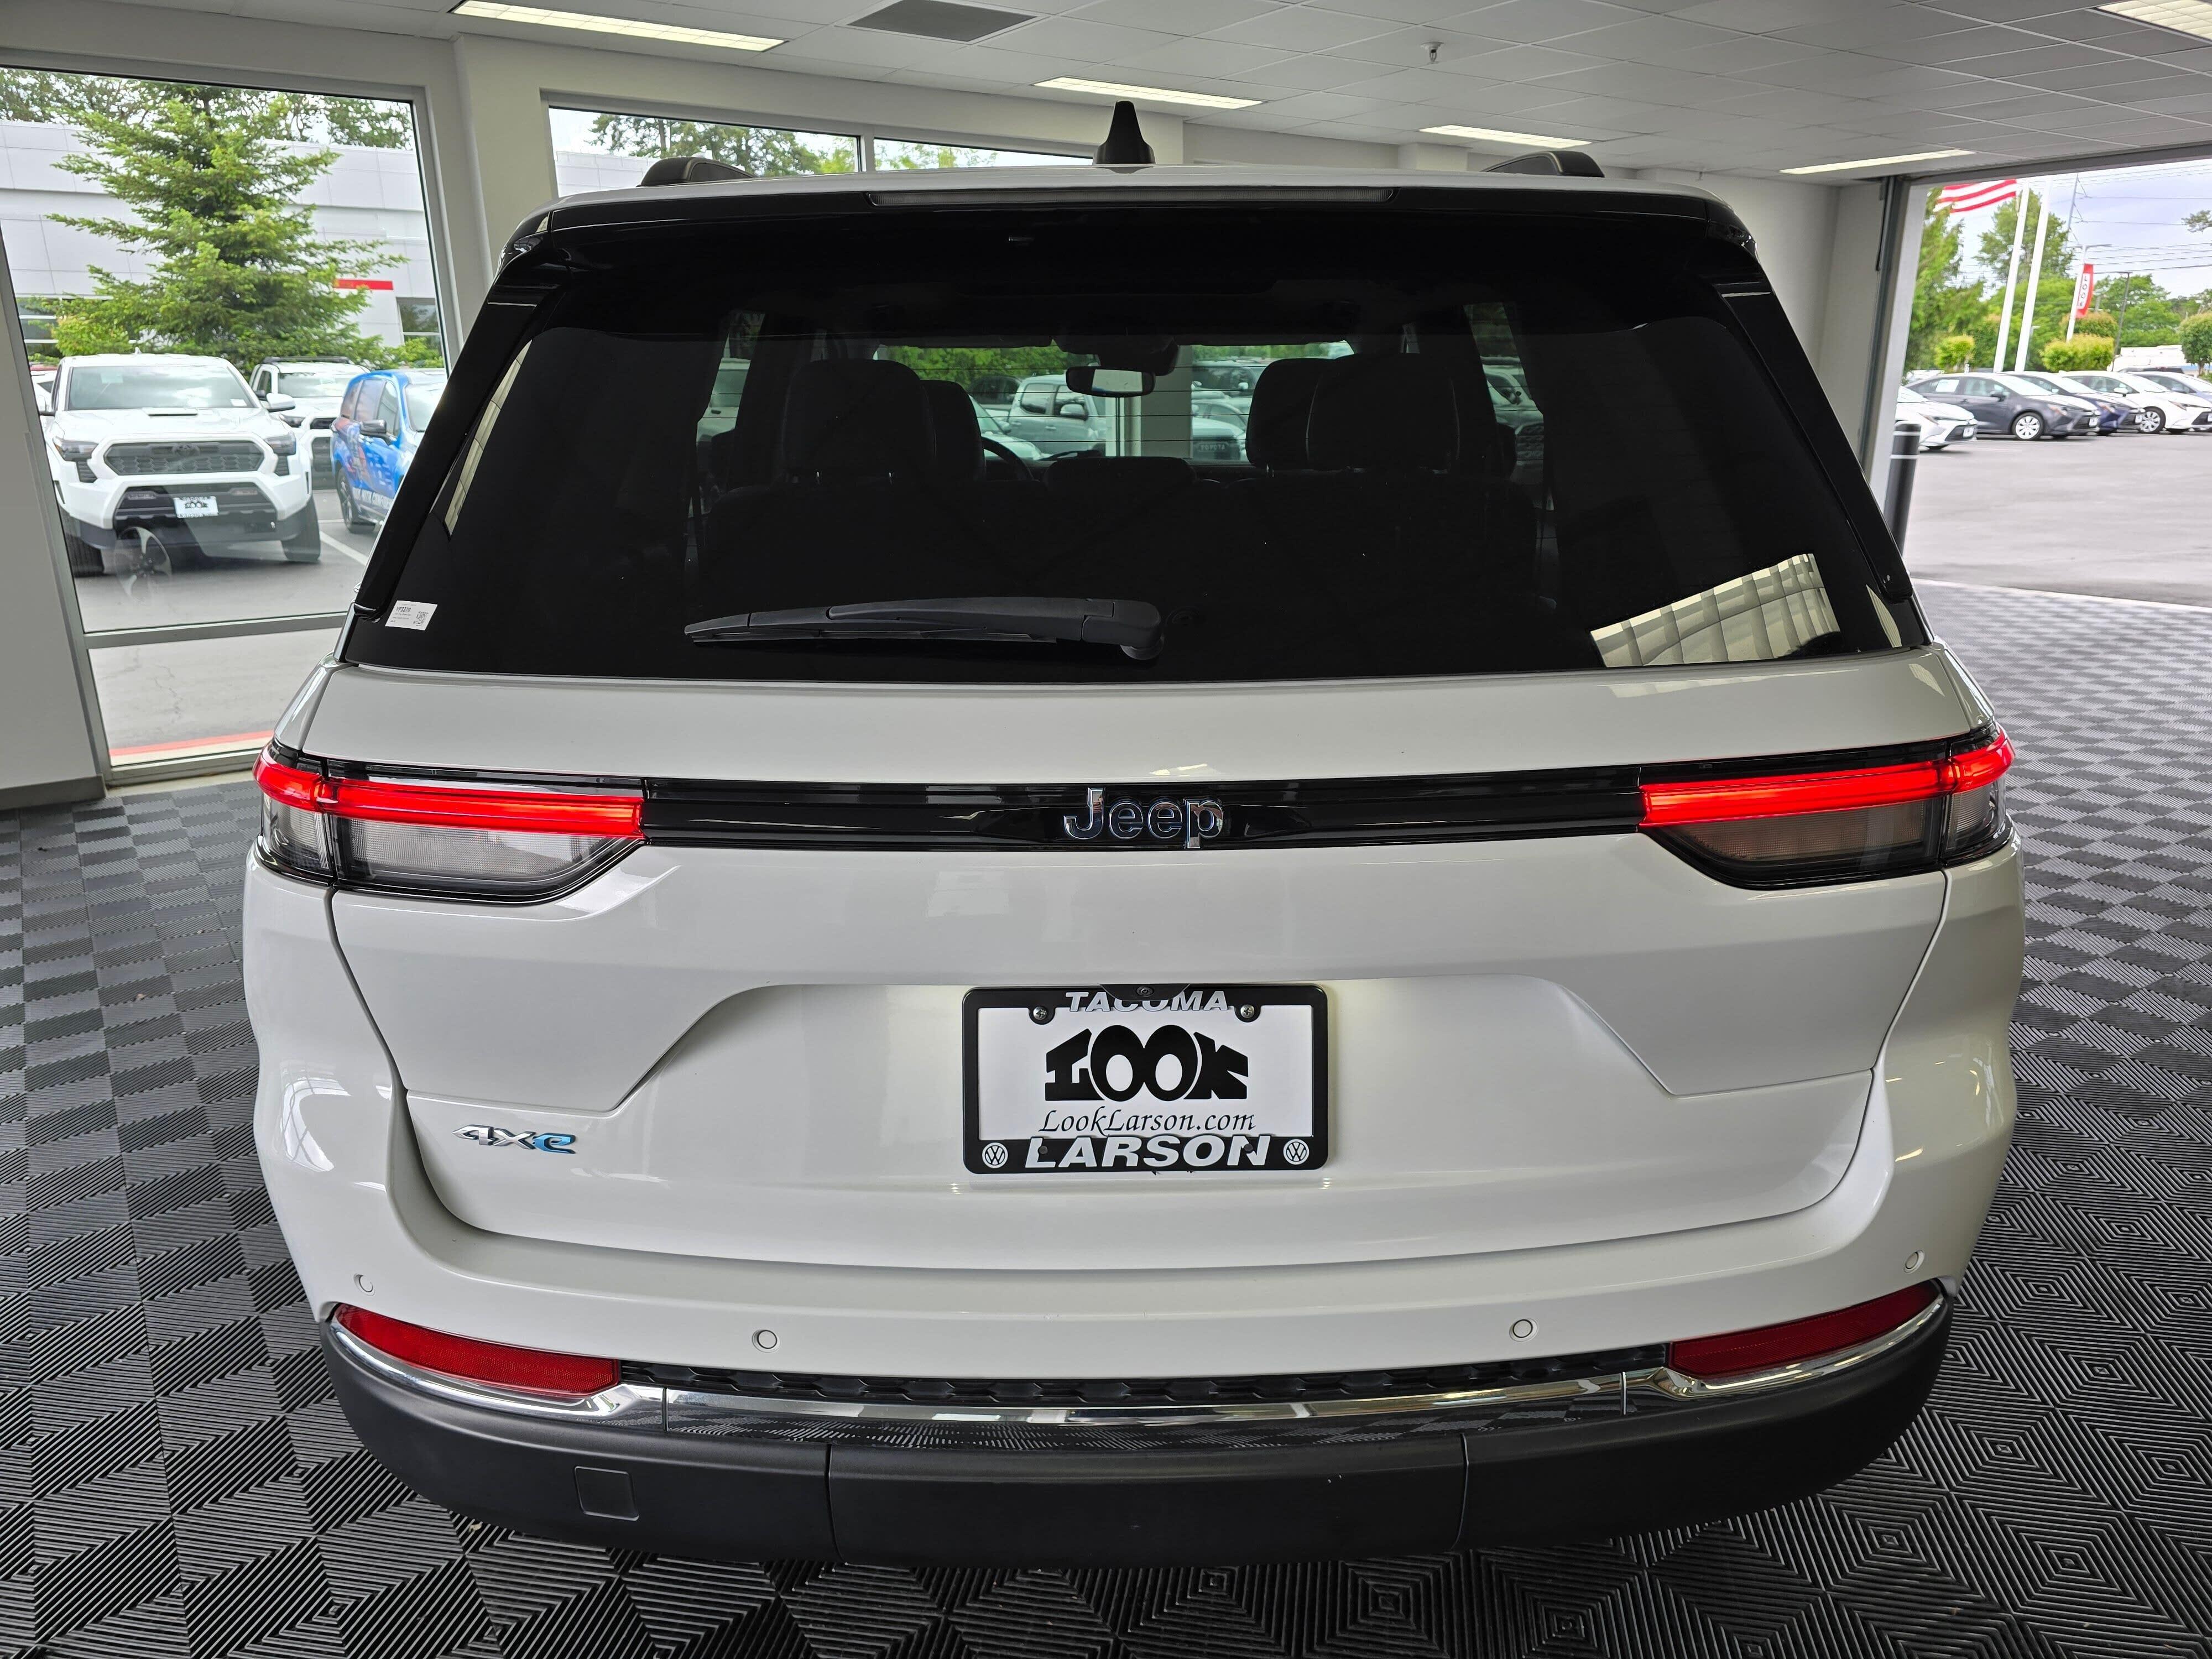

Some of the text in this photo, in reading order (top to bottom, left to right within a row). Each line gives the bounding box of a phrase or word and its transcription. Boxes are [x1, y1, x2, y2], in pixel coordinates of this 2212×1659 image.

[1062, 787, 1224, 849] Jeep
[1045, 1025, 1249, 1102] LOOK
[1038, 1106, 1256, 1136] LookLarson.com
[1025, 1134, 1271, 1168] LARSON
